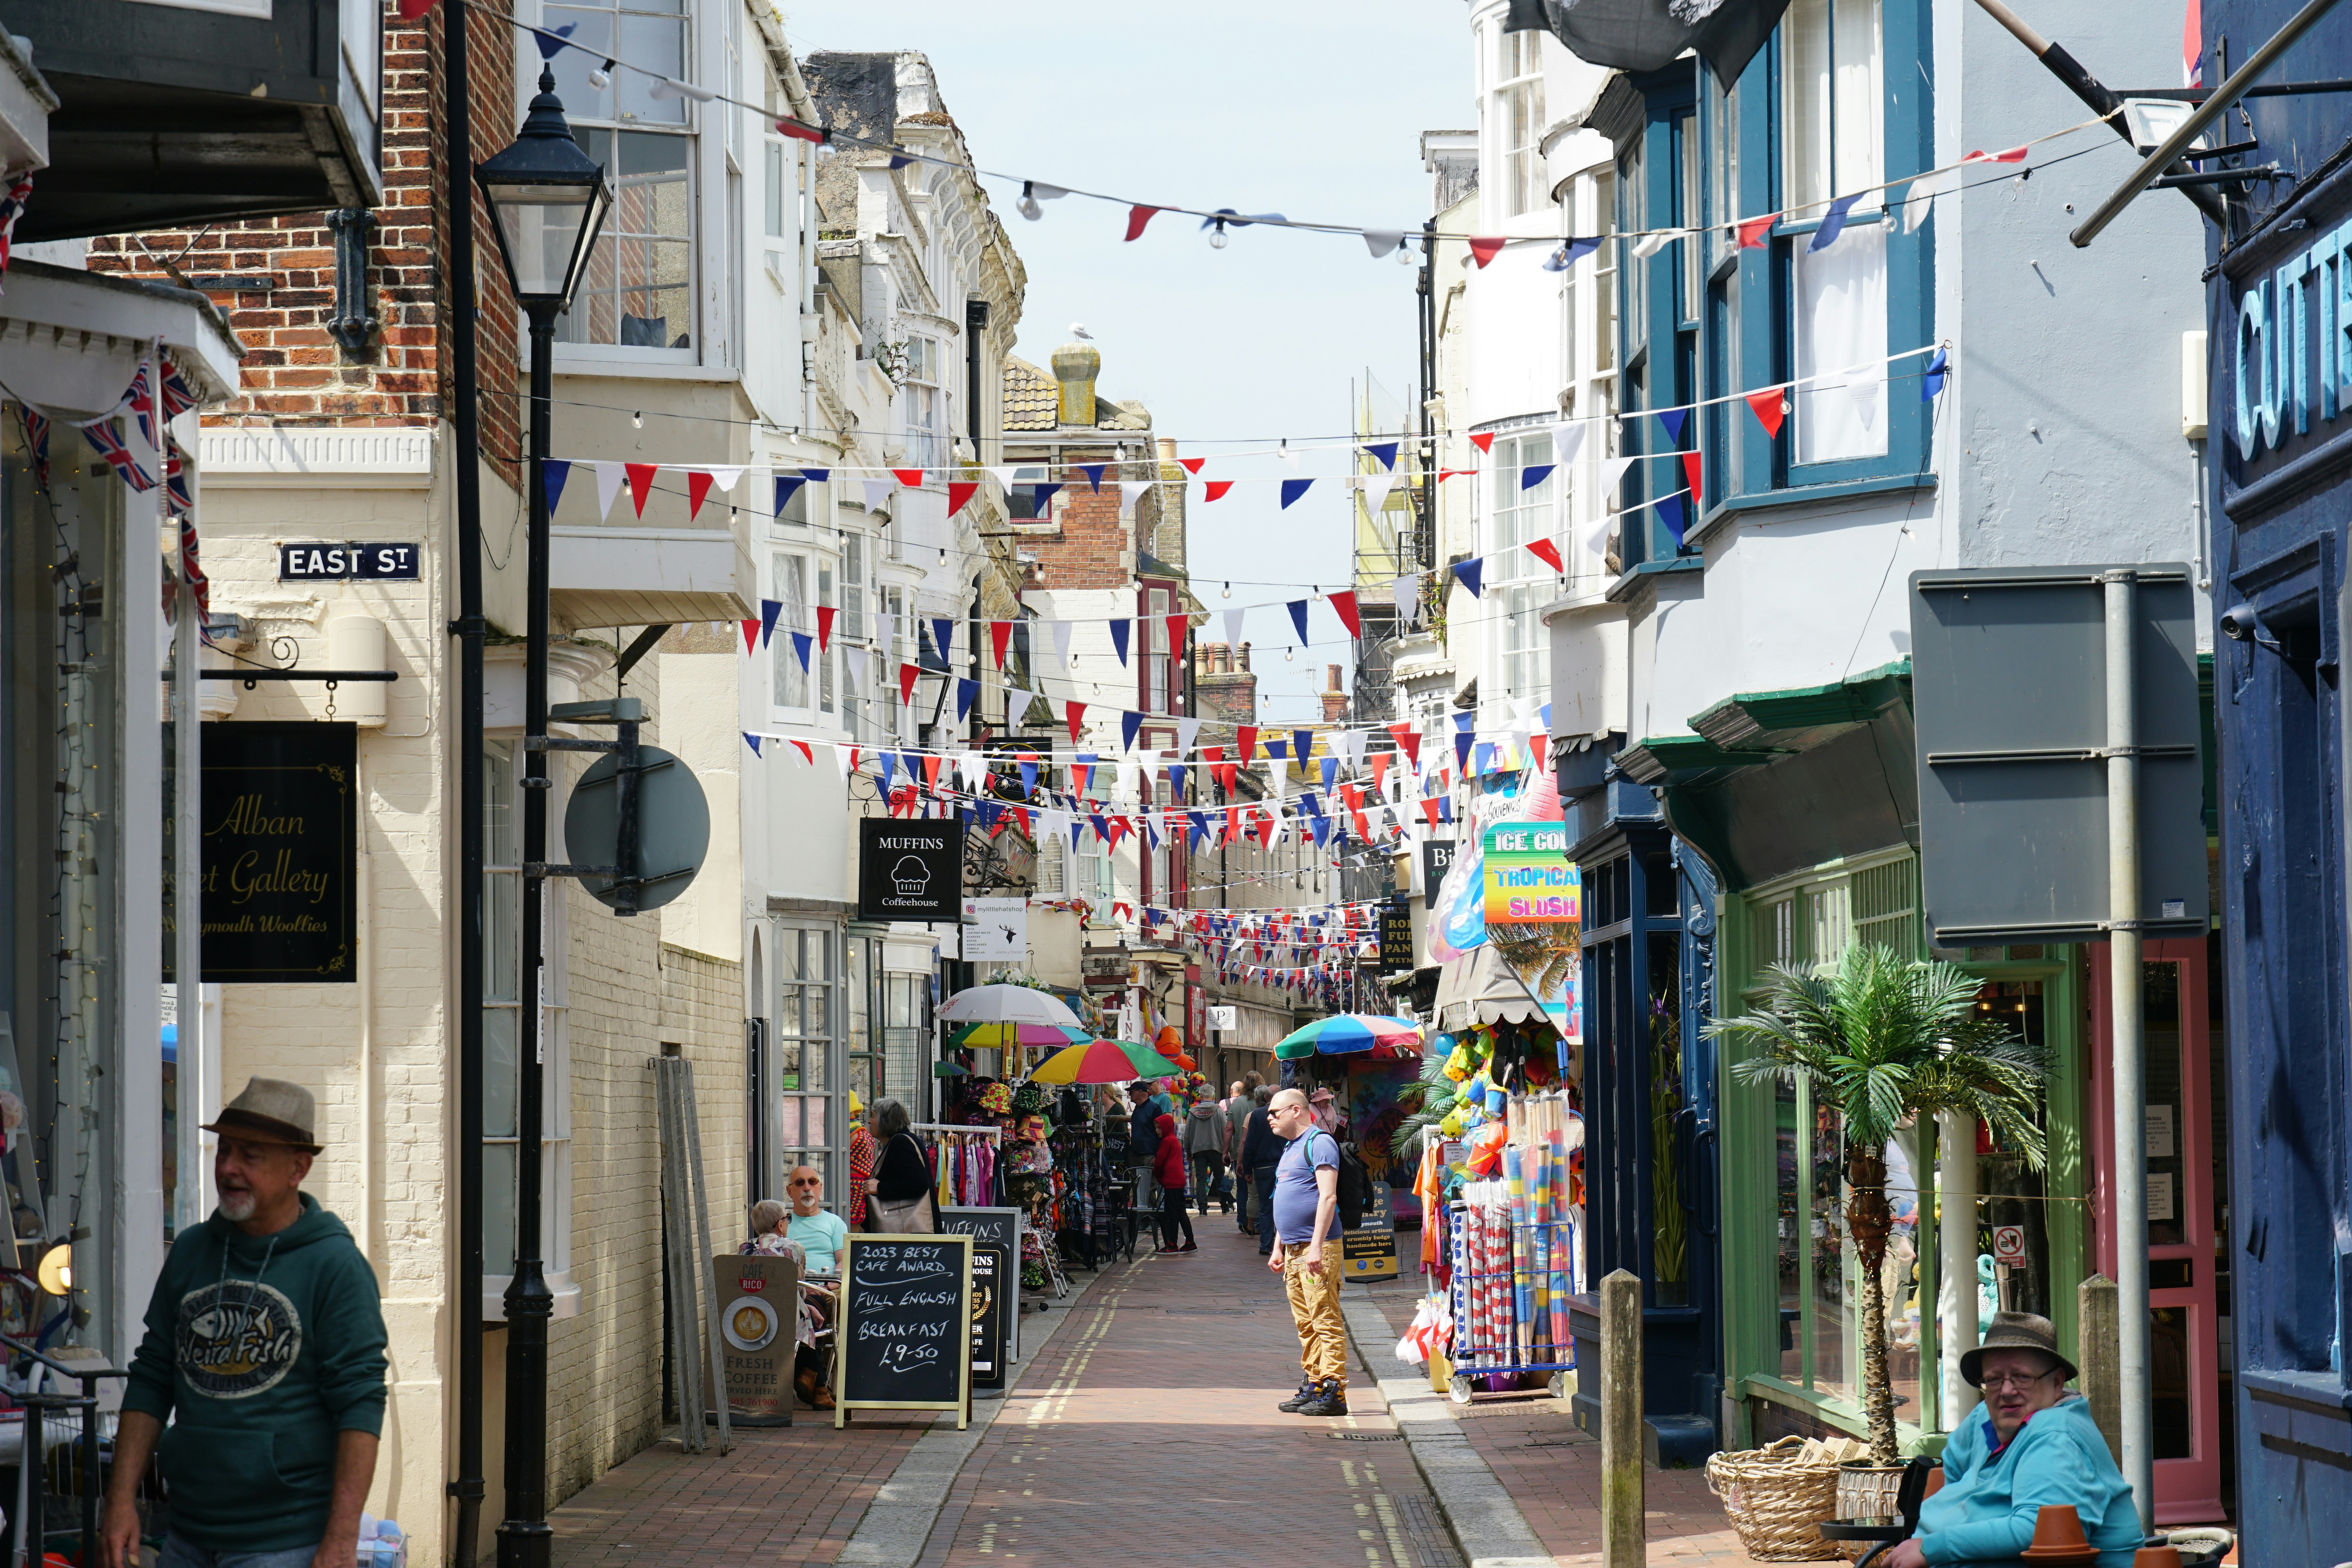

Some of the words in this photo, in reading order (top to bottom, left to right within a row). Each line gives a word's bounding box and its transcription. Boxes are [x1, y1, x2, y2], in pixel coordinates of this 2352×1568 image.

[289, 548, 363, 574] EAST
[205, 794, 305, 835] Alban
[879, 837, 944, 850] MUFFINS
[1496, 829, 1528, 851] ICE
[1534, 829, 1567, 851] COL
[1432, 848, 1453, 866] Bi
[231, 849, 328, 904] Gallery
[882, 897, 938, 907] Coffeehouse
[1508, 896, 1577, 917] SLUSH
[201, 915, 255, 937] ymouth
[260, 915, 327, 932] Woollies
[1385, 944, 1412, 953] PAN
[1217, 1011, 1225, 1020] P
[860, 1245, 897, 1258] 2023
[903, 1246, 942, 1259] BEST
[742, 1263, 763, 1279] CAFÉ
[856, 1260, 889, 1272] CAFE
[896, 1260, 945, 1272] AWARD
[743, 1280, 762, 1289] RICO
[854, 1291, 893, 1308] FULL
[858, 1319, 950, 1341] BREAKFAST
[235, 1329, 292, 1365] Fish
[726, 1356, 773, 1369] FRESH
[724, 1371, 777, 1385] COFFEE
[747, 1398, 778, 1406] 761900
